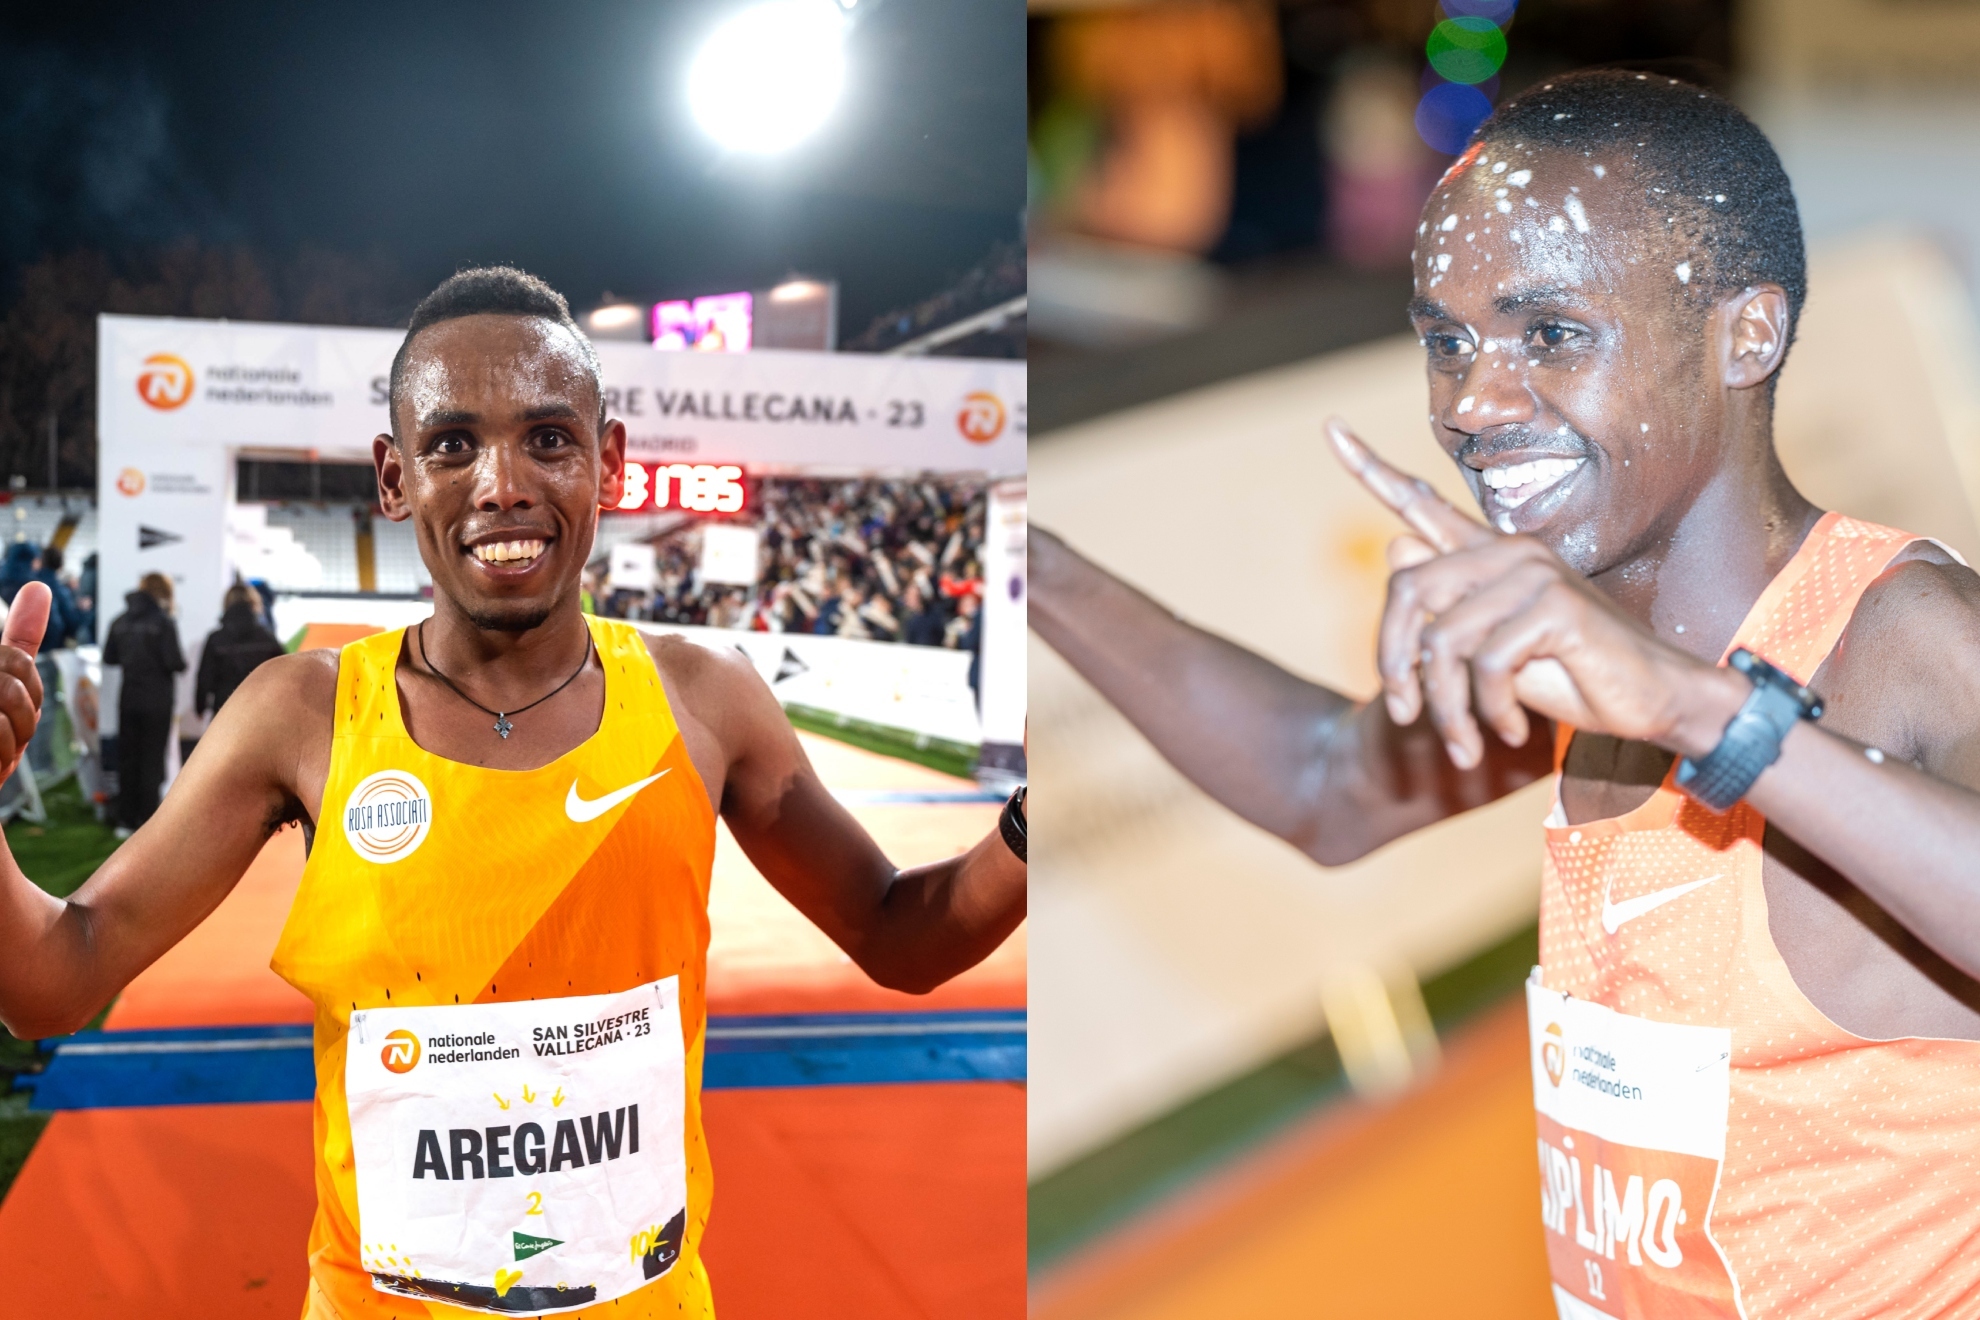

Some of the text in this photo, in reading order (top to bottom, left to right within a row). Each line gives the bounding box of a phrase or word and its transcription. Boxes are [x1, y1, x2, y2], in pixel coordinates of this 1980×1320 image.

[656, 390, 857, 425] VALLECANA
[886, 402, 924, 427] 23
[349, 799, 426, 831] ROSA ASSOCIATI
[429, 1032, 495, 1047] nationale
[533, 1008, 649, 1041] SAN SILVESTRE
[533, 1022, 651, 1057] VALLECANA 23
[429, 1046, 519, 1064] nederlanden
[412, 1104, 640, 1180] AREGAWI
[525, 1192, 543, 1215] 2
[630, 1225, 669, 1265] 10K
[1584, 1258, 1607, 1301] 12
